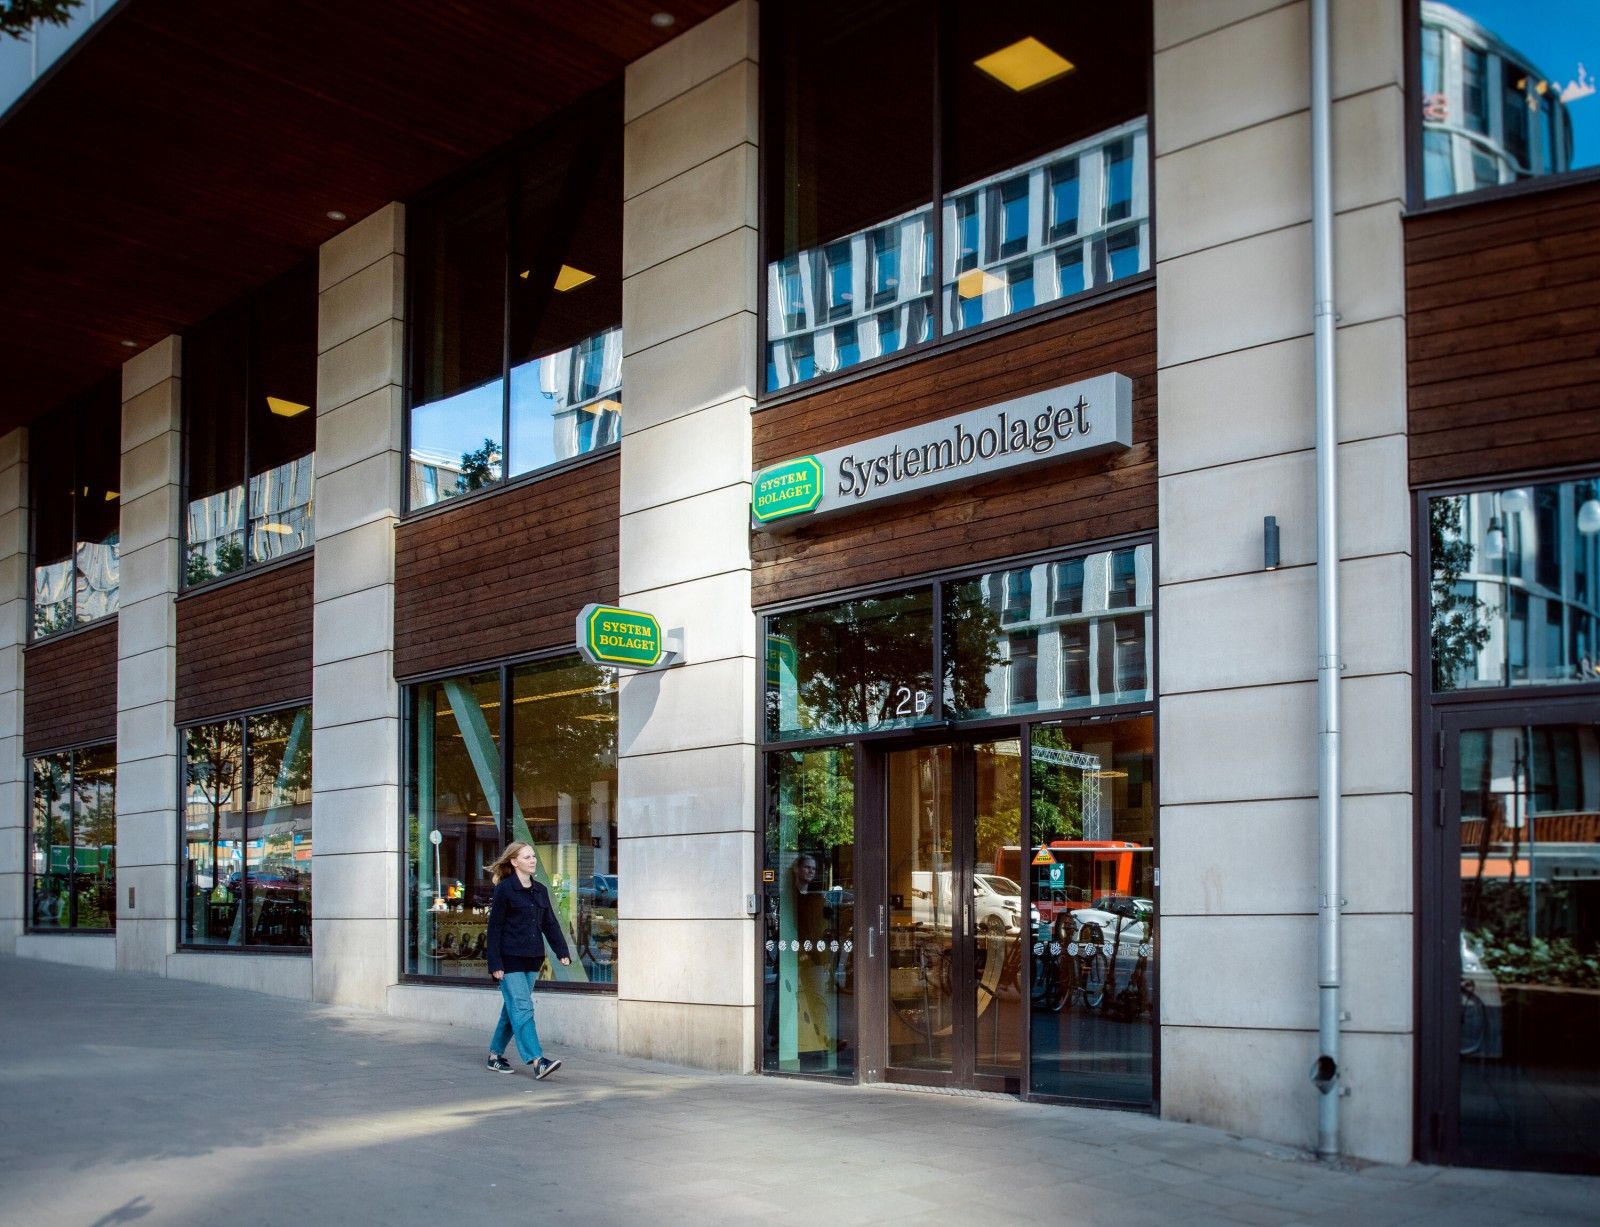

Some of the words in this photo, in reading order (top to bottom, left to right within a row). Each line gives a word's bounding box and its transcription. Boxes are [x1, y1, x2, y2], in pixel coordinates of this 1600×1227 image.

[838, 394, 1091, 498] Systembolaget
[760, 470, 808, 492] SYSTEM
[757, 483, 812, 507] BOLAGET
[602, 621, 652, 637] SYSTEM
[599, 634, 655, 651] BOLAGET
[895, 687, 927, 715] 2B
